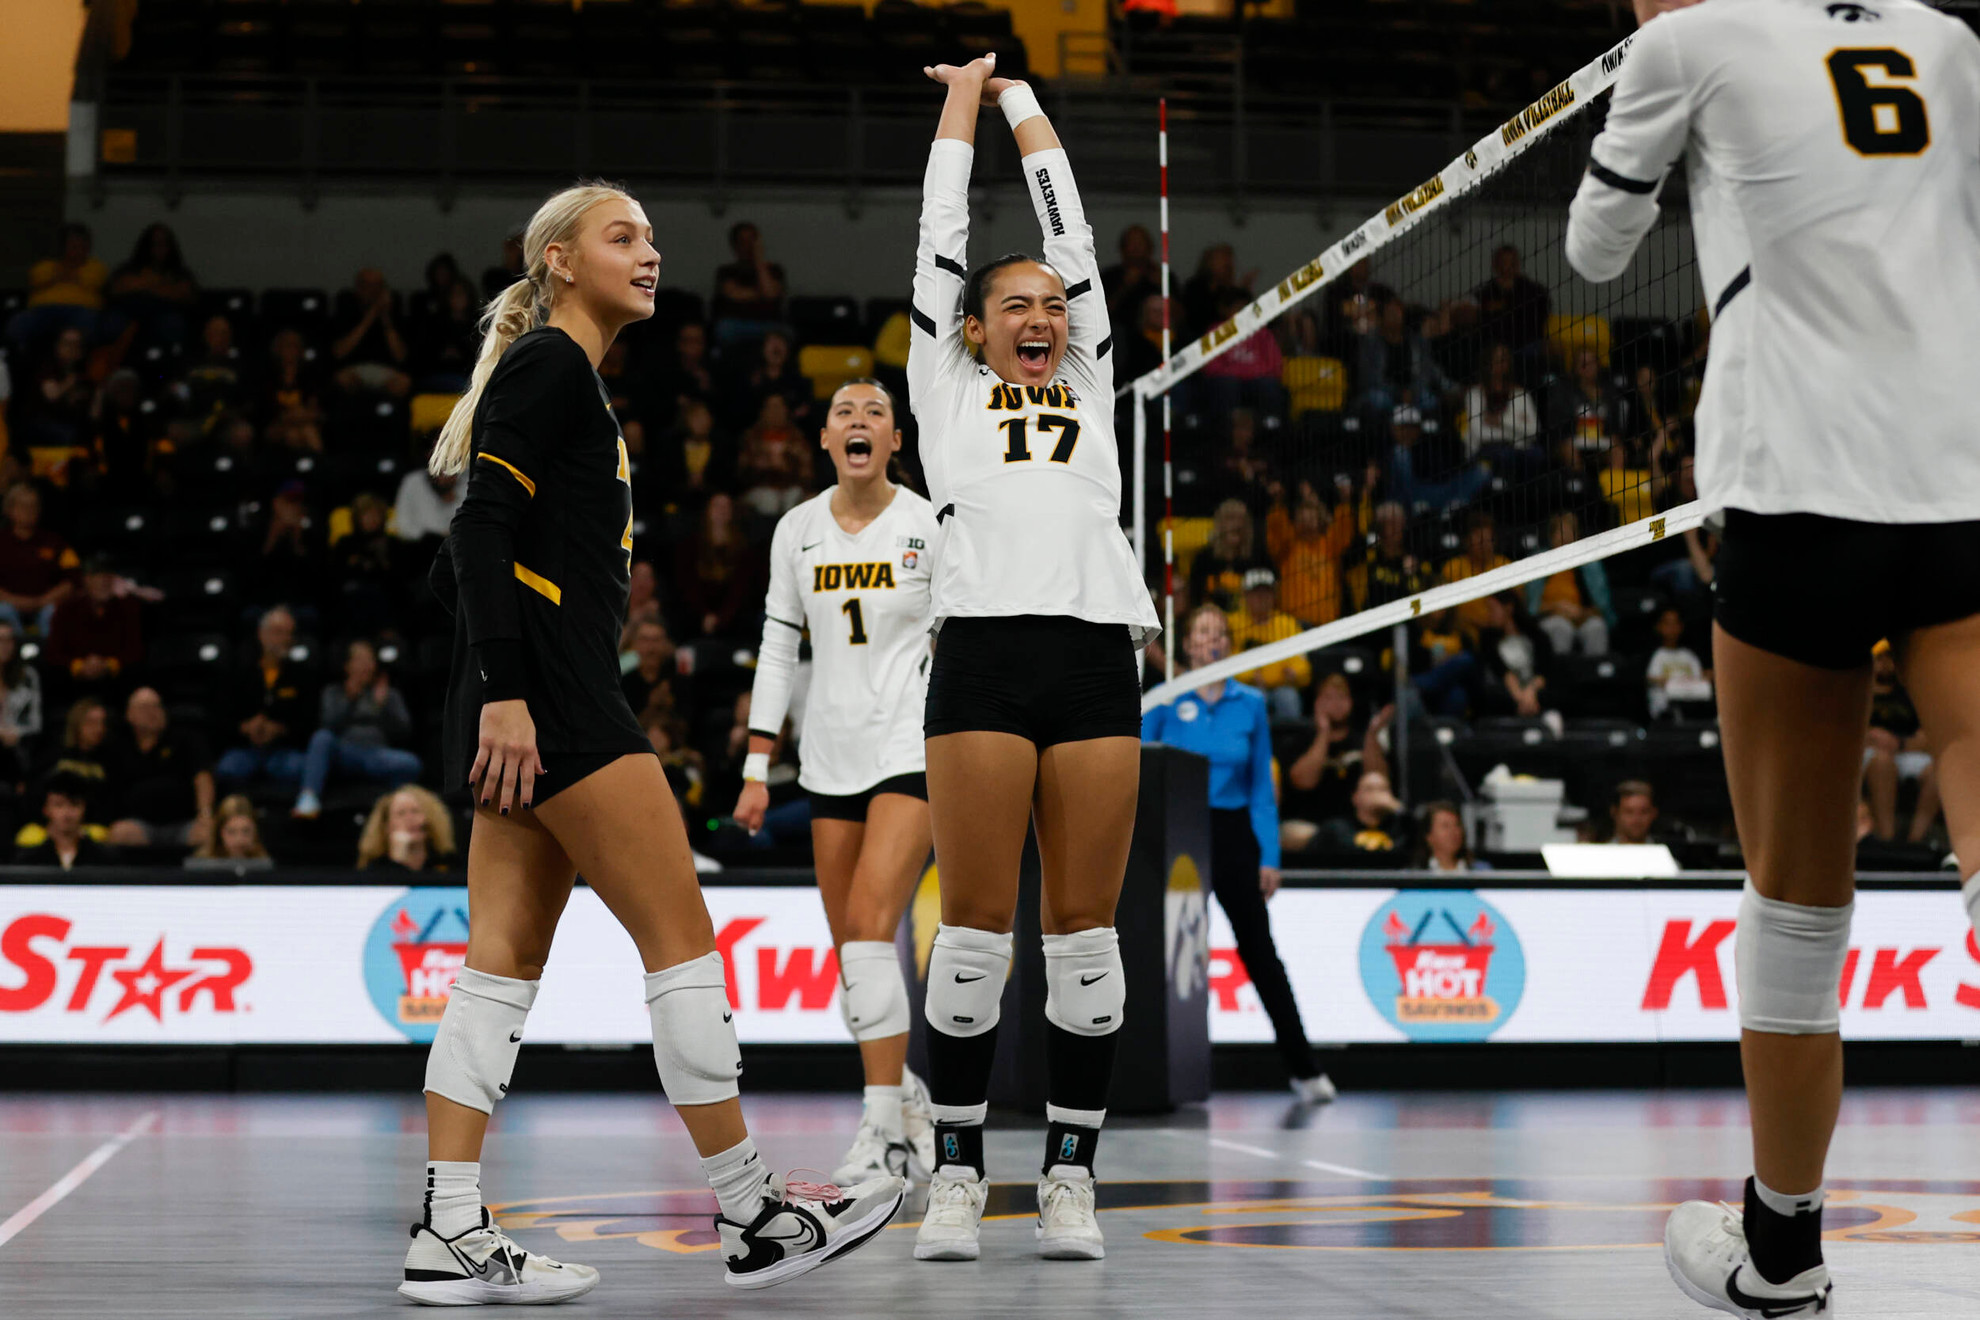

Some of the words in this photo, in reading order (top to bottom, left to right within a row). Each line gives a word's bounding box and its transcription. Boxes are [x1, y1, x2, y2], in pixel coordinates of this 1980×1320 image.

[1822, 46, 1932, 159] 6
[1035, 167, 1065, 237] HAWKEYES
[998, 413, 1081, 465] 17
[813, 561, 896, 593] IOWA
[841, 597, 868, 646] 1
[1405, 968, 1481, 999] HOT
